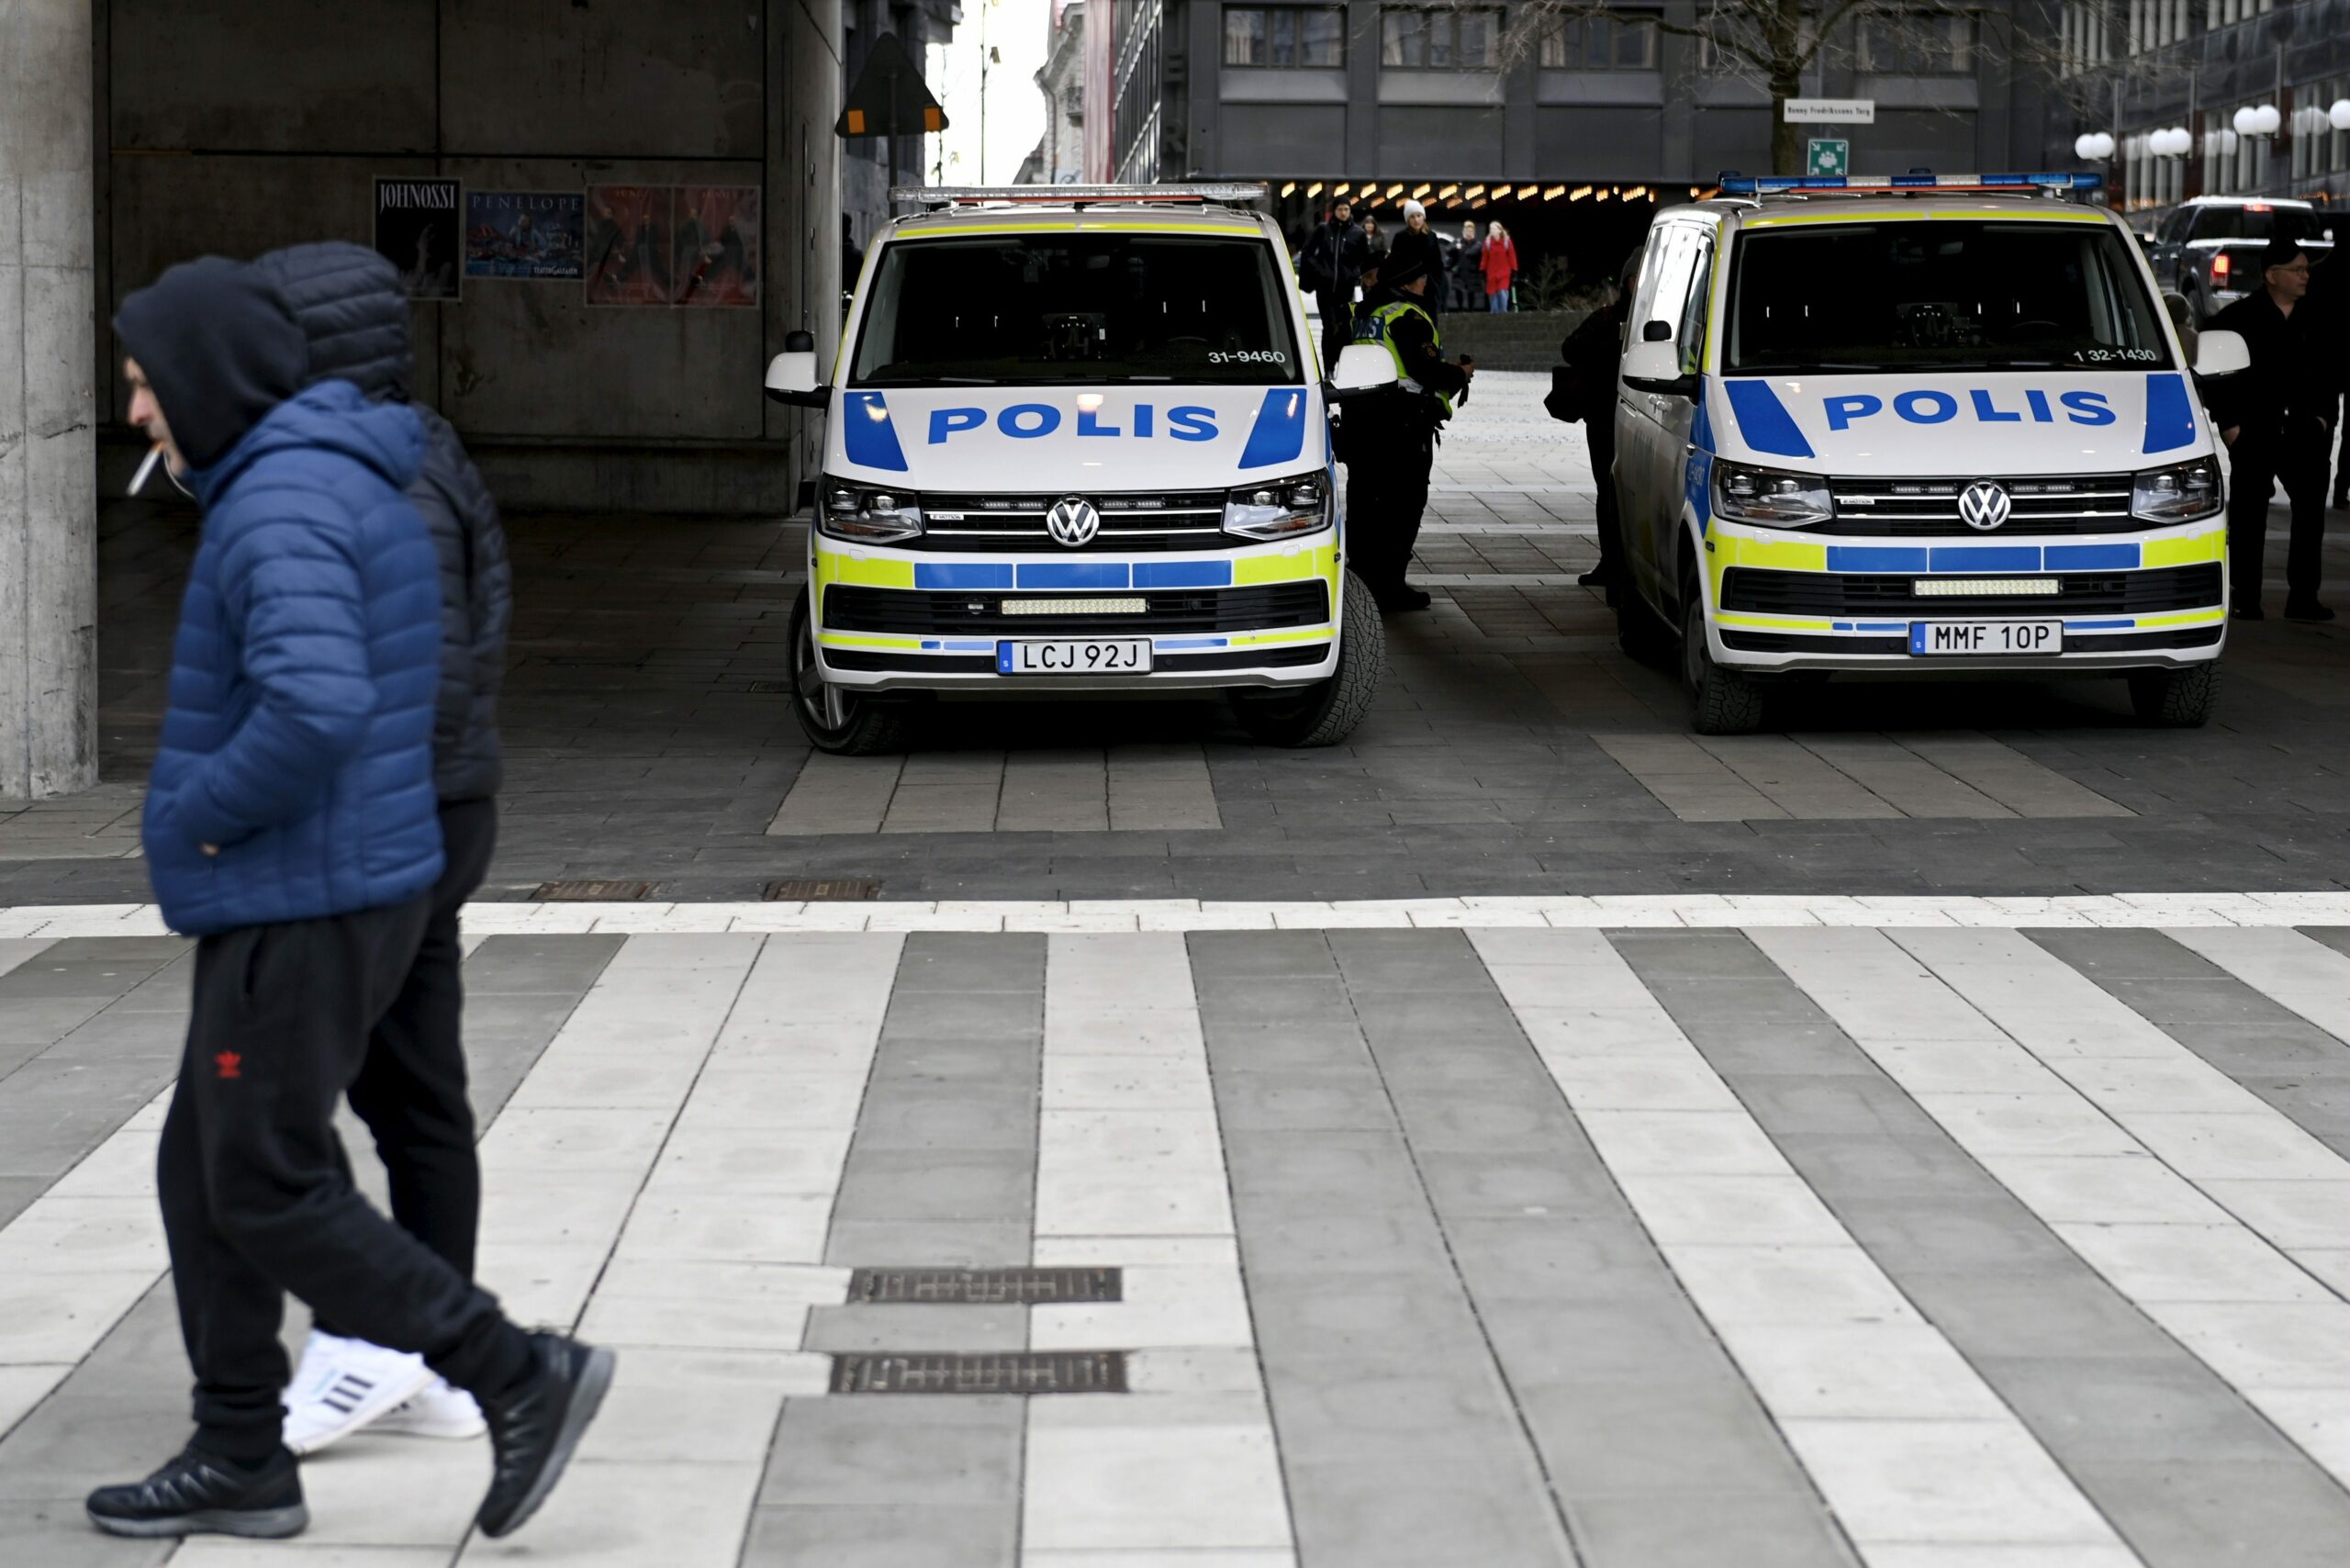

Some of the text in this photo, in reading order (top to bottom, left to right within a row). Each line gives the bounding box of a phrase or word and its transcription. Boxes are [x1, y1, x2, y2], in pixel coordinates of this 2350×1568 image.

[379, 184, 455, 215] JOHNOSSI
[472, 195, 579, 211] PENELOPE
[1208, 351, 1286, 364] 31-9460
[2087, 349, 2156, 362] 32-1430
[1822, 389, 2116, 431] POLIS
[928, 403, 1219, 445] POLIS
[1935, 626, 1986, 650] MMF
[1024, 645, 1074, 668] LCJ
[1085, 644, 1137, 668] 92J
